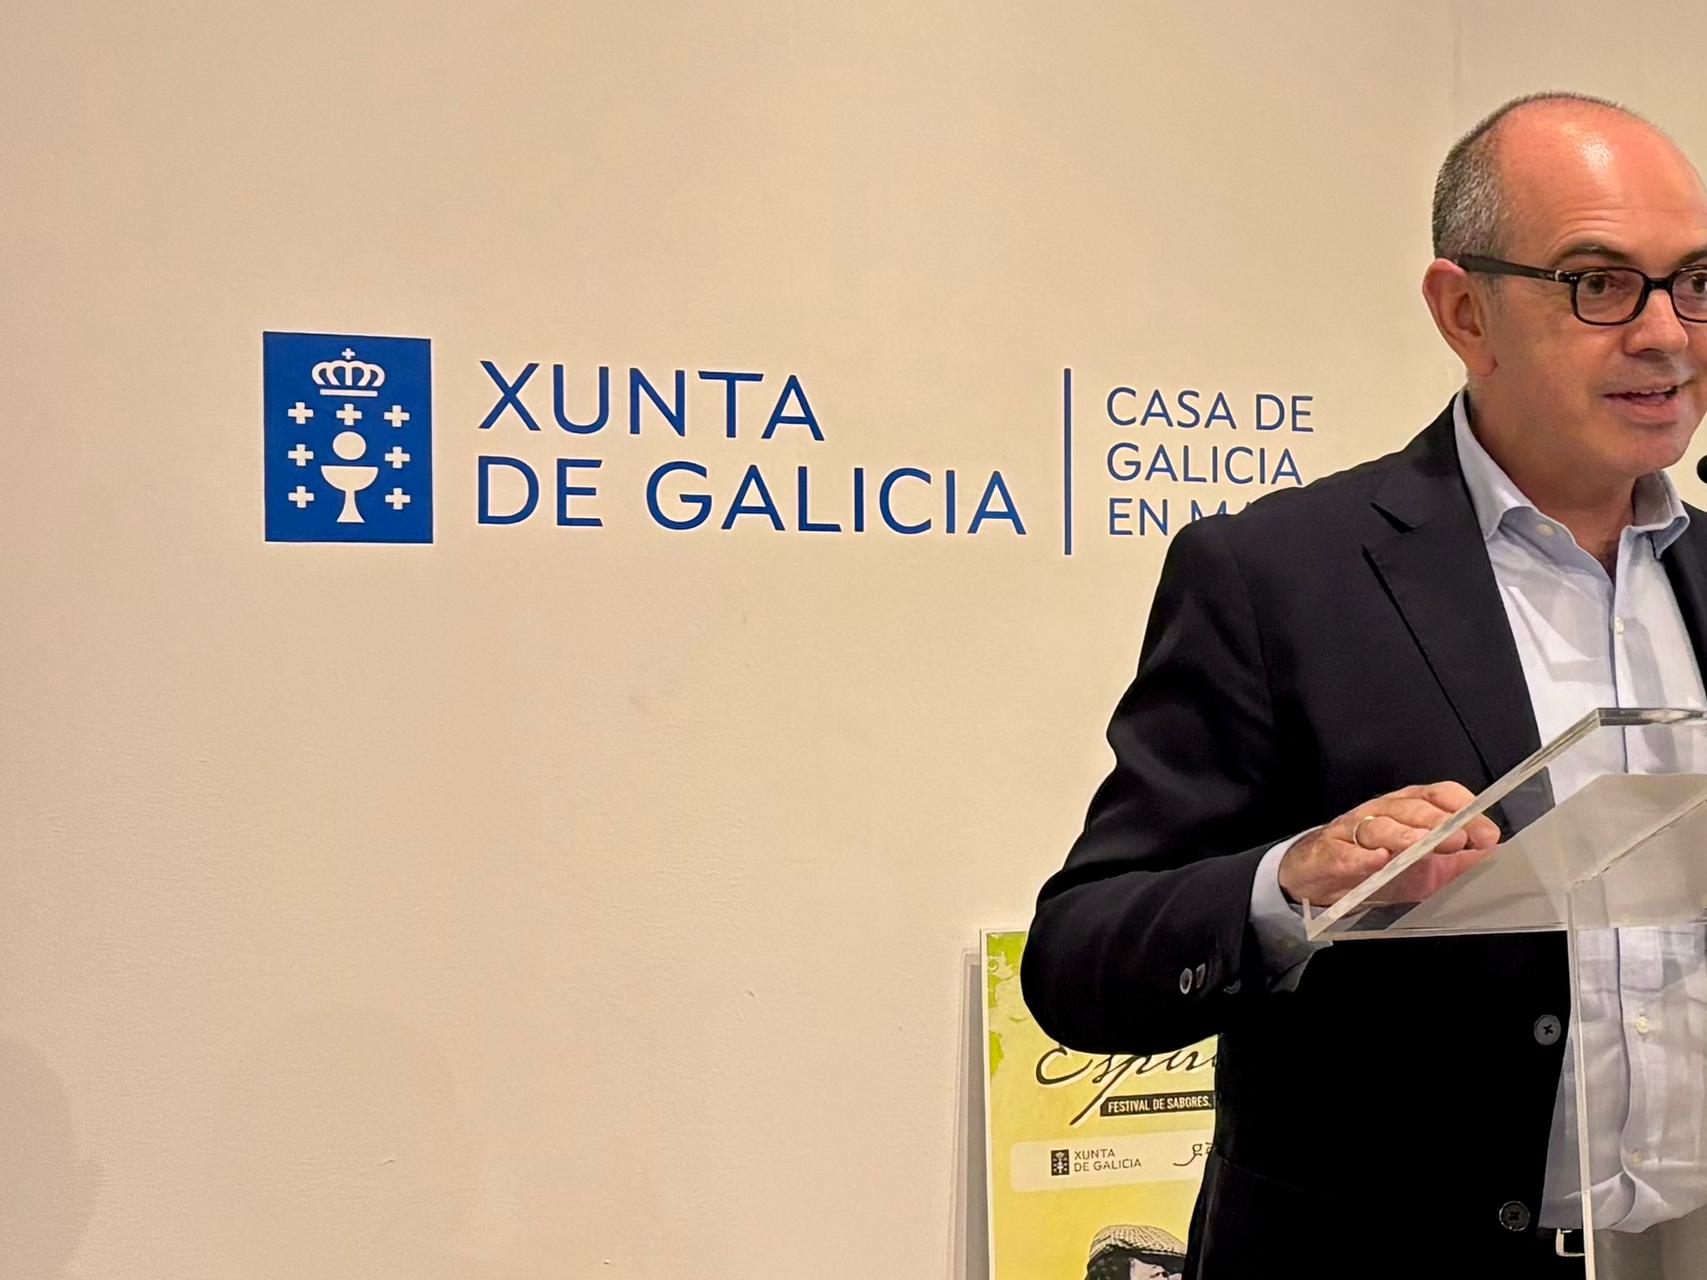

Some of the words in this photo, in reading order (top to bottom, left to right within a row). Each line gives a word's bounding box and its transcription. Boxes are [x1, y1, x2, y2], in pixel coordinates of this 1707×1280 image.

[478, 359, 825, 442] XUNTA
[1106, 387, 1237, 429] CASA
[1256, 394, 1314, 432] DE
[1107, 442, 1302, 485] GALICIA
[477, 457, 604, 528] DE
[643, 460, 1027, 537] GALICIA
[1109, 498, 1168, 535] EN
[1108, 1099, 1150, 1113] FESTIVAL
[1153, 1098, 1165, 1110] DE
[1074, 1149, 1115, 1160] XUNTA
[1074, 1161, 1090, 1172] DE
[1094, 1158, 1142, 1171] GALICIA
